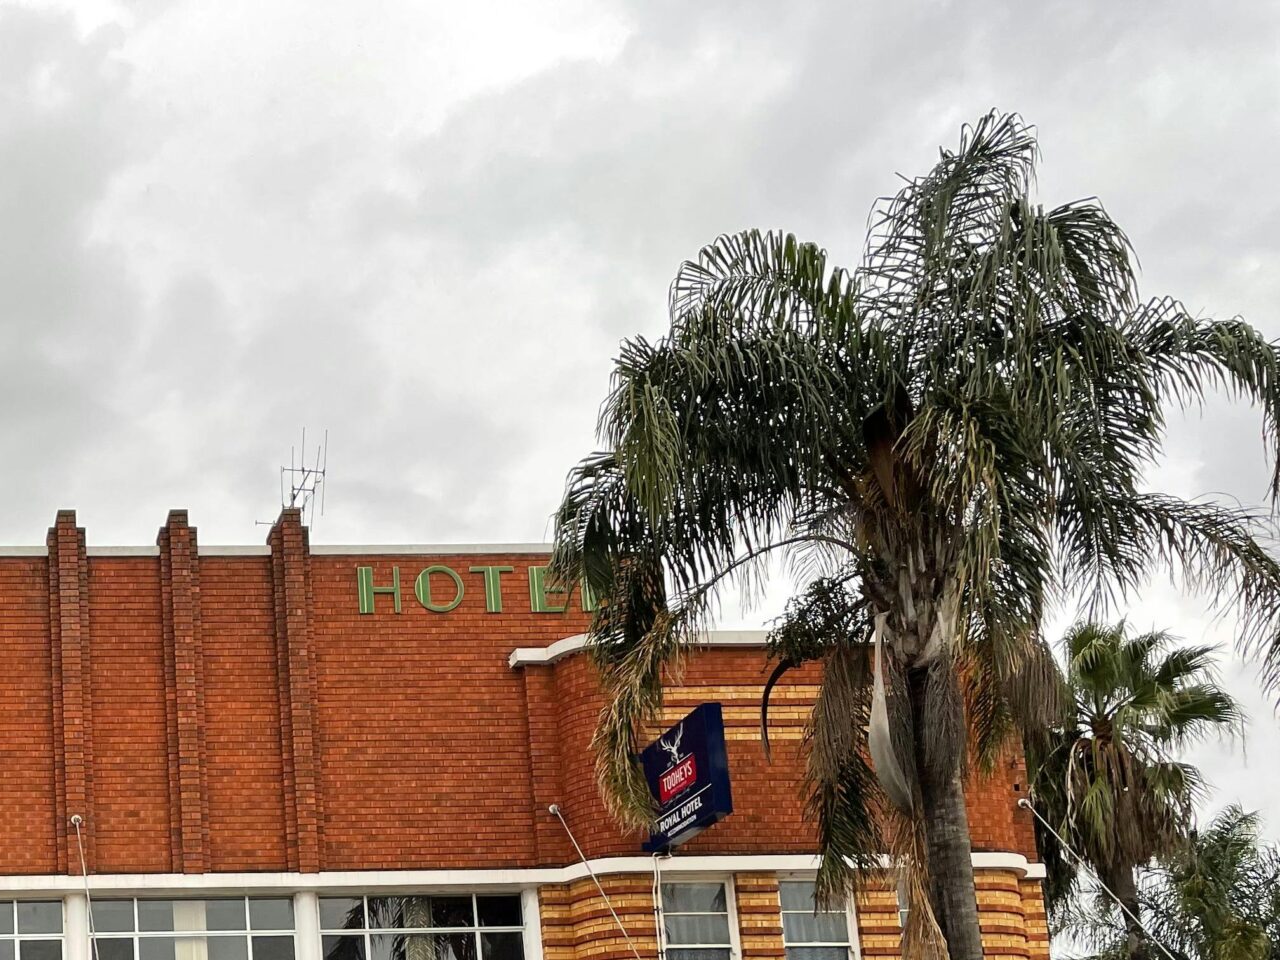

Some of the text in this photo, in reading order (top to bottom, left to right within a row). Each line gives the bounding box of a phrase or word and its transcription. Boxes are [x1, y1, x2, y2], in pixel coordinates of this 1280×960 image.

[662, 760, 693, 792] TOOHEYS
[660, 796, 703, 832] ROYAL HOTEL
